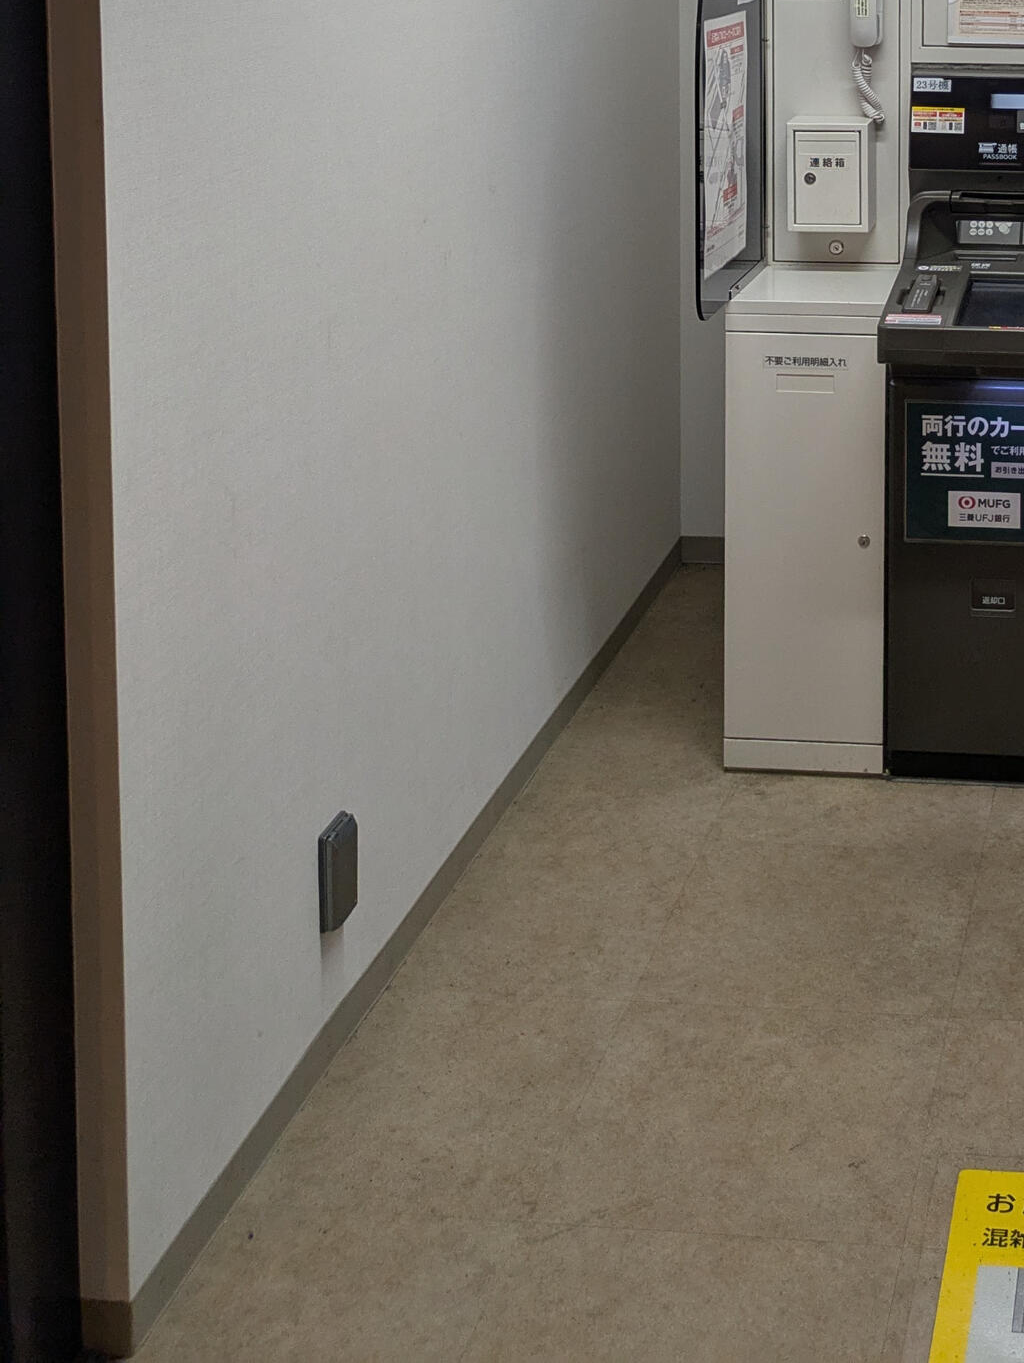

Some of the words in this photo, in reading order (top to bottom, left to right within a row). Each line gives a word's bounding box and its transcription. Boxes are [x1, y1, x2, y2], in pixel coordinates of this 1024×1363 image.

[915, 79, 951, 91] 23号機
[997, 143, 1018, 154] 通帳
[809, 157, 845, 168] 連絡箱
[765, 356, 847, 368] 不要ご利用明細入れ
[920, 440, 984, 472] 無料
[977, 498, 1011, 509] MUFG
[959, 513, 1011, 523] 三菱UFJ銀行
